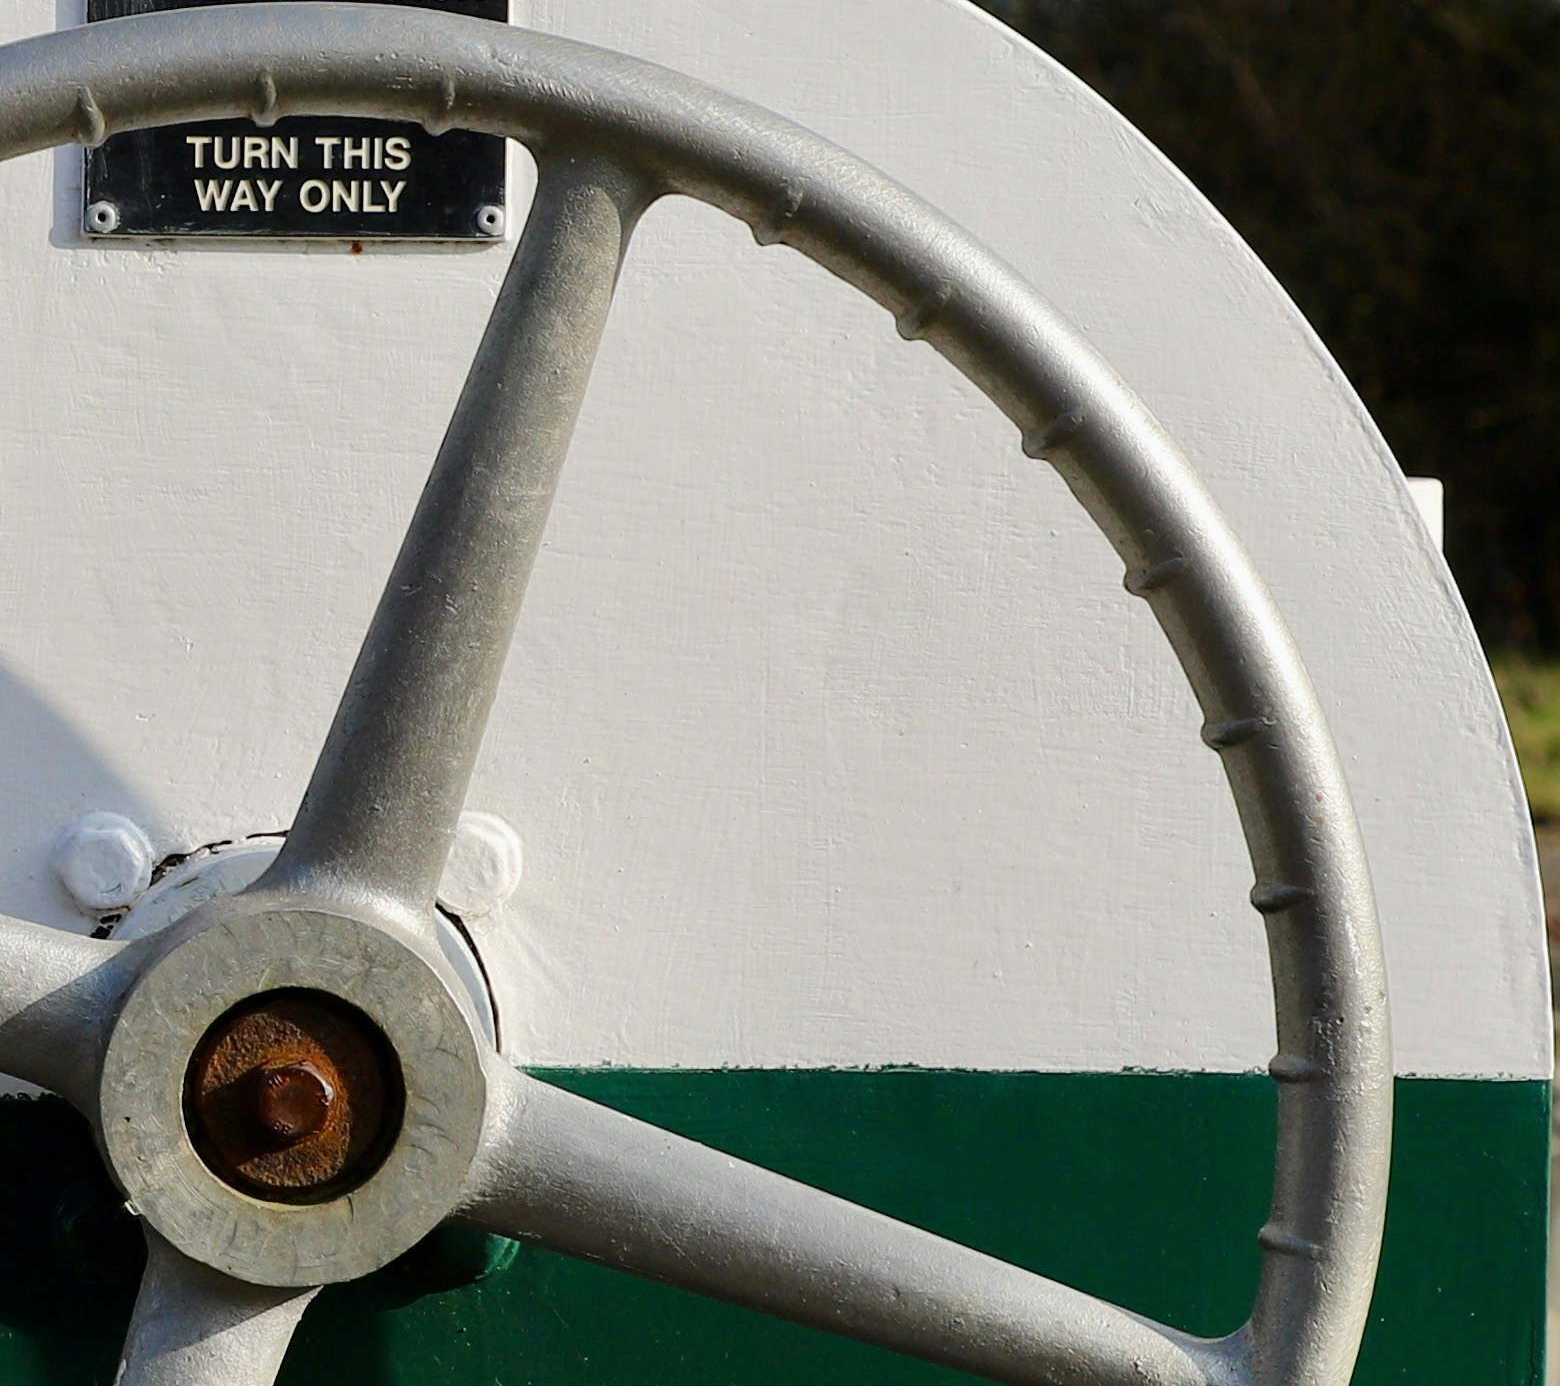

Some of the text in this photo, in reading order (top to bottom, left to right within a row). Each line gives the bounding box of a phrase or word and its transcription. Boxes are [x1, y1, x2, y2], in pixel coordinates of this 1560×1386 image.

[186, 135, 412, 170] TURN THIS
[194, 179, 408, 213] WAY ONLY
